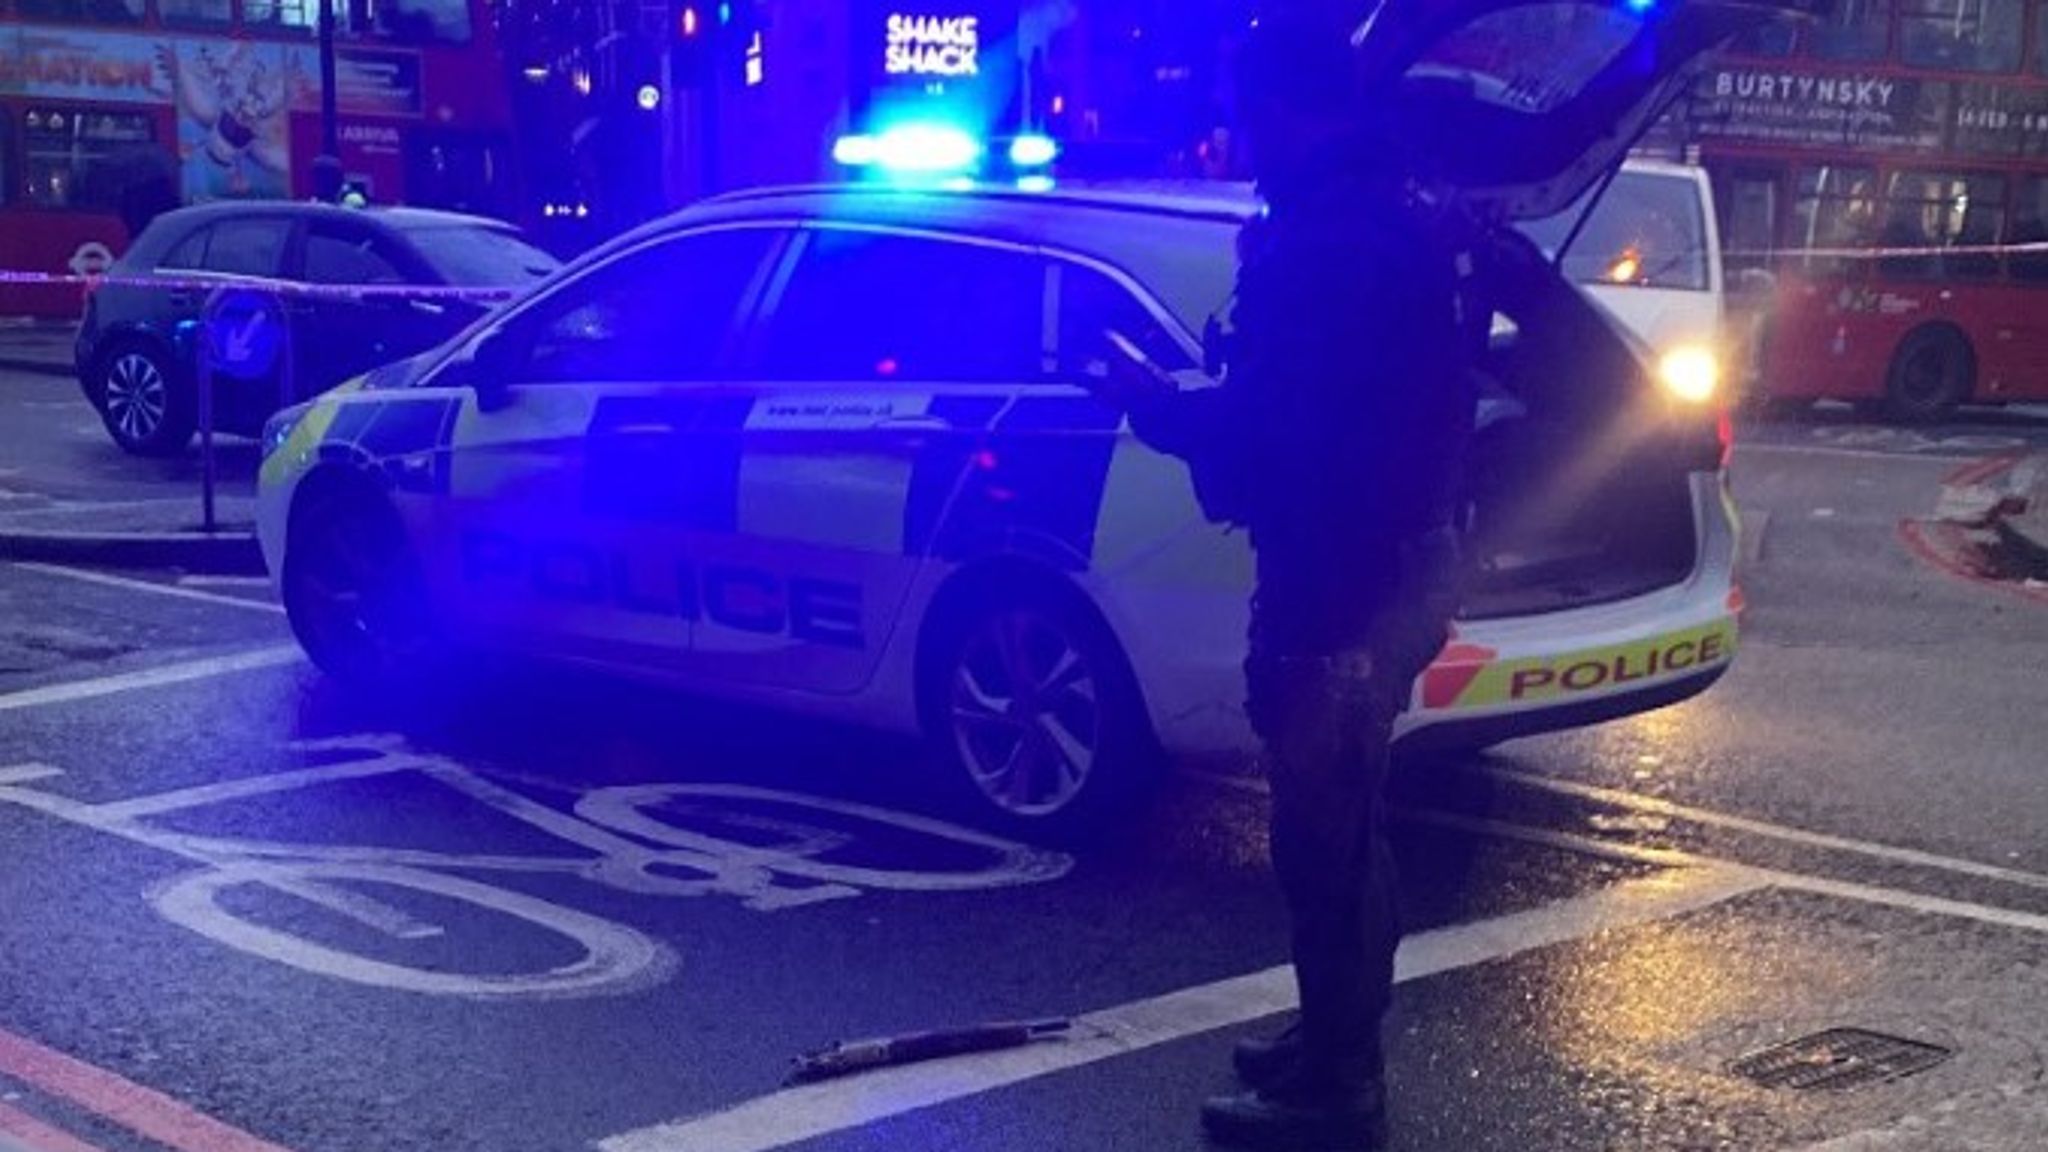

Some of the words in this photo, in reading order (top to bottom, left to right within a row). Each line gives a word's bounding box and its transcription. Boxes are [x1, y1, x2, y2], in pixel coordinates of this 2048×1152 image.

[886, 14, 977, 44] SHAKE
[885, 44, 978, 74] SHACK
[1716, 73, 1893, 106] BURTYNSKY
[461, 530, 866, 650] POLICE
[1510, 633, 1724, 699] POLICE
